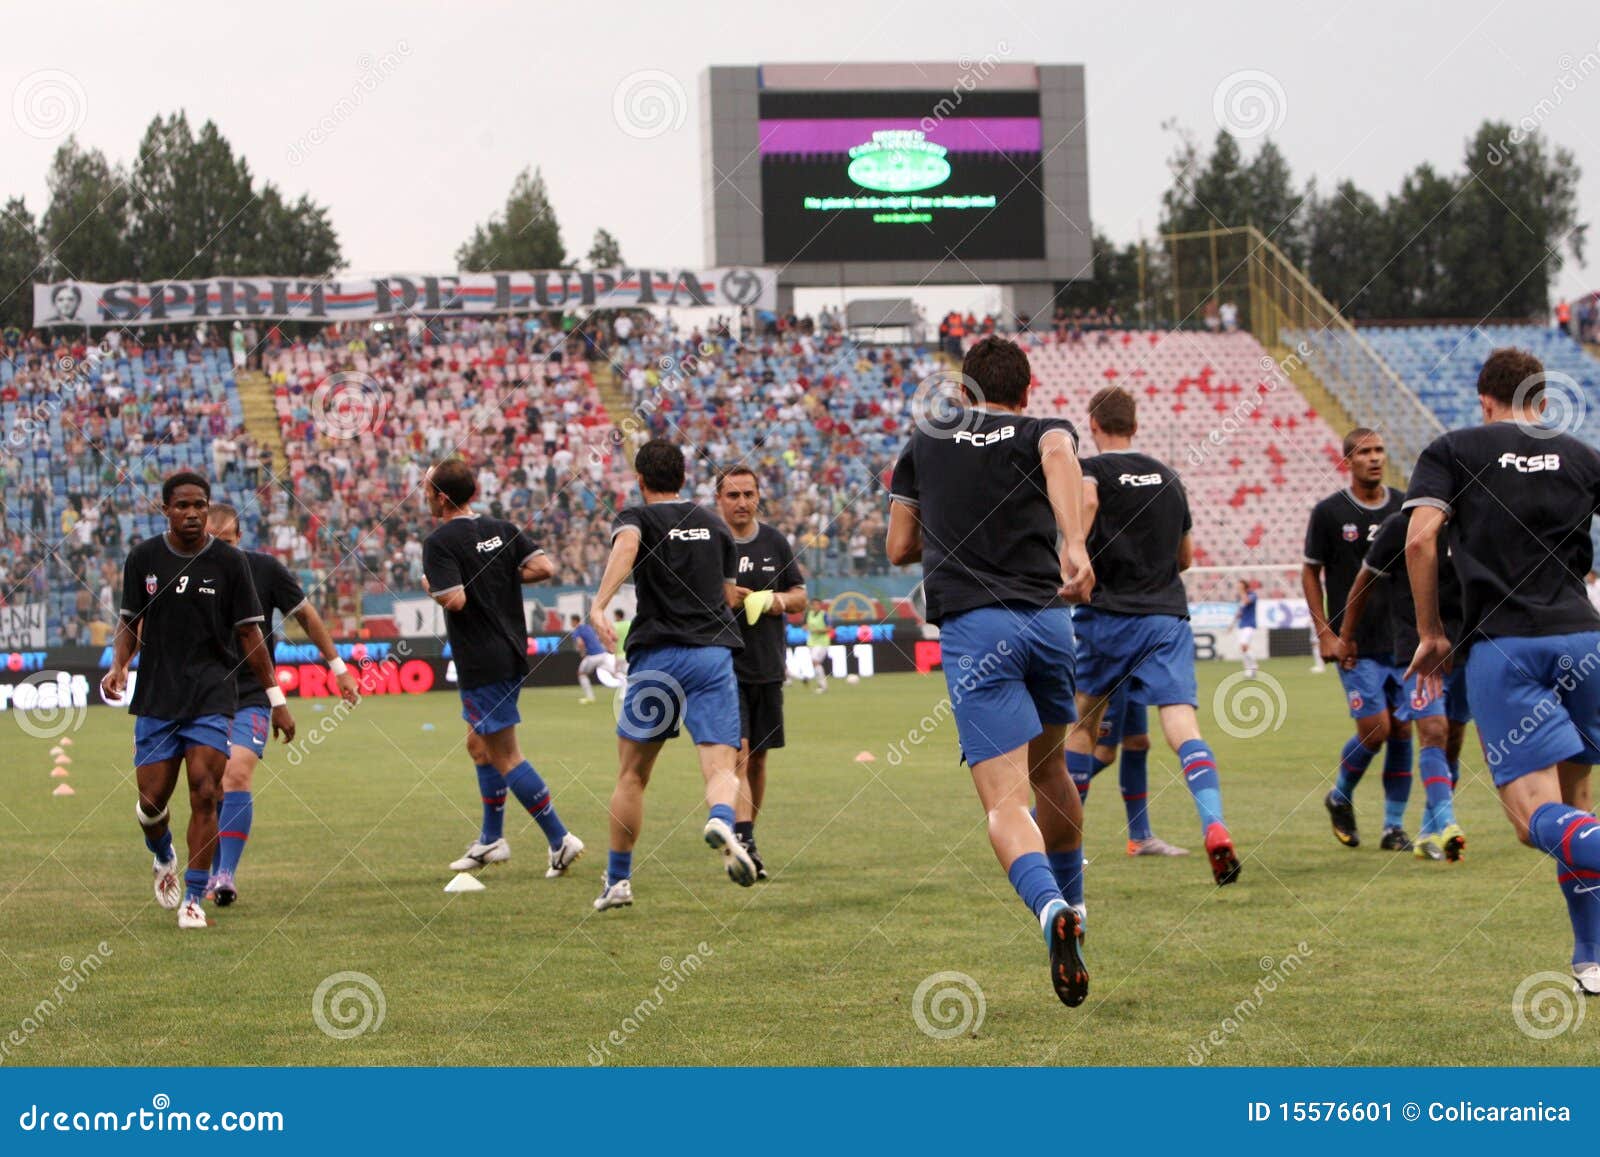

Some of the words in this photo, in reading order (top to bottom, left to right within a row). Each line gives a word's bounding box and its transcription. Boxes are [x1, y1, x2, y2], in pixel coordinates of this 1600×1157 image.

[101, 276, 343, 321] SPIRIT
[370, 275, 464, 314] DE
[953, 425, 1015, 447] FCSB
[1498, 452, 1560, 473] FCSB
[1118, 473, 1163, 487] FCSB
[668, 528, 711, 541] FCSB
[176, 575, 189, 594] 3
